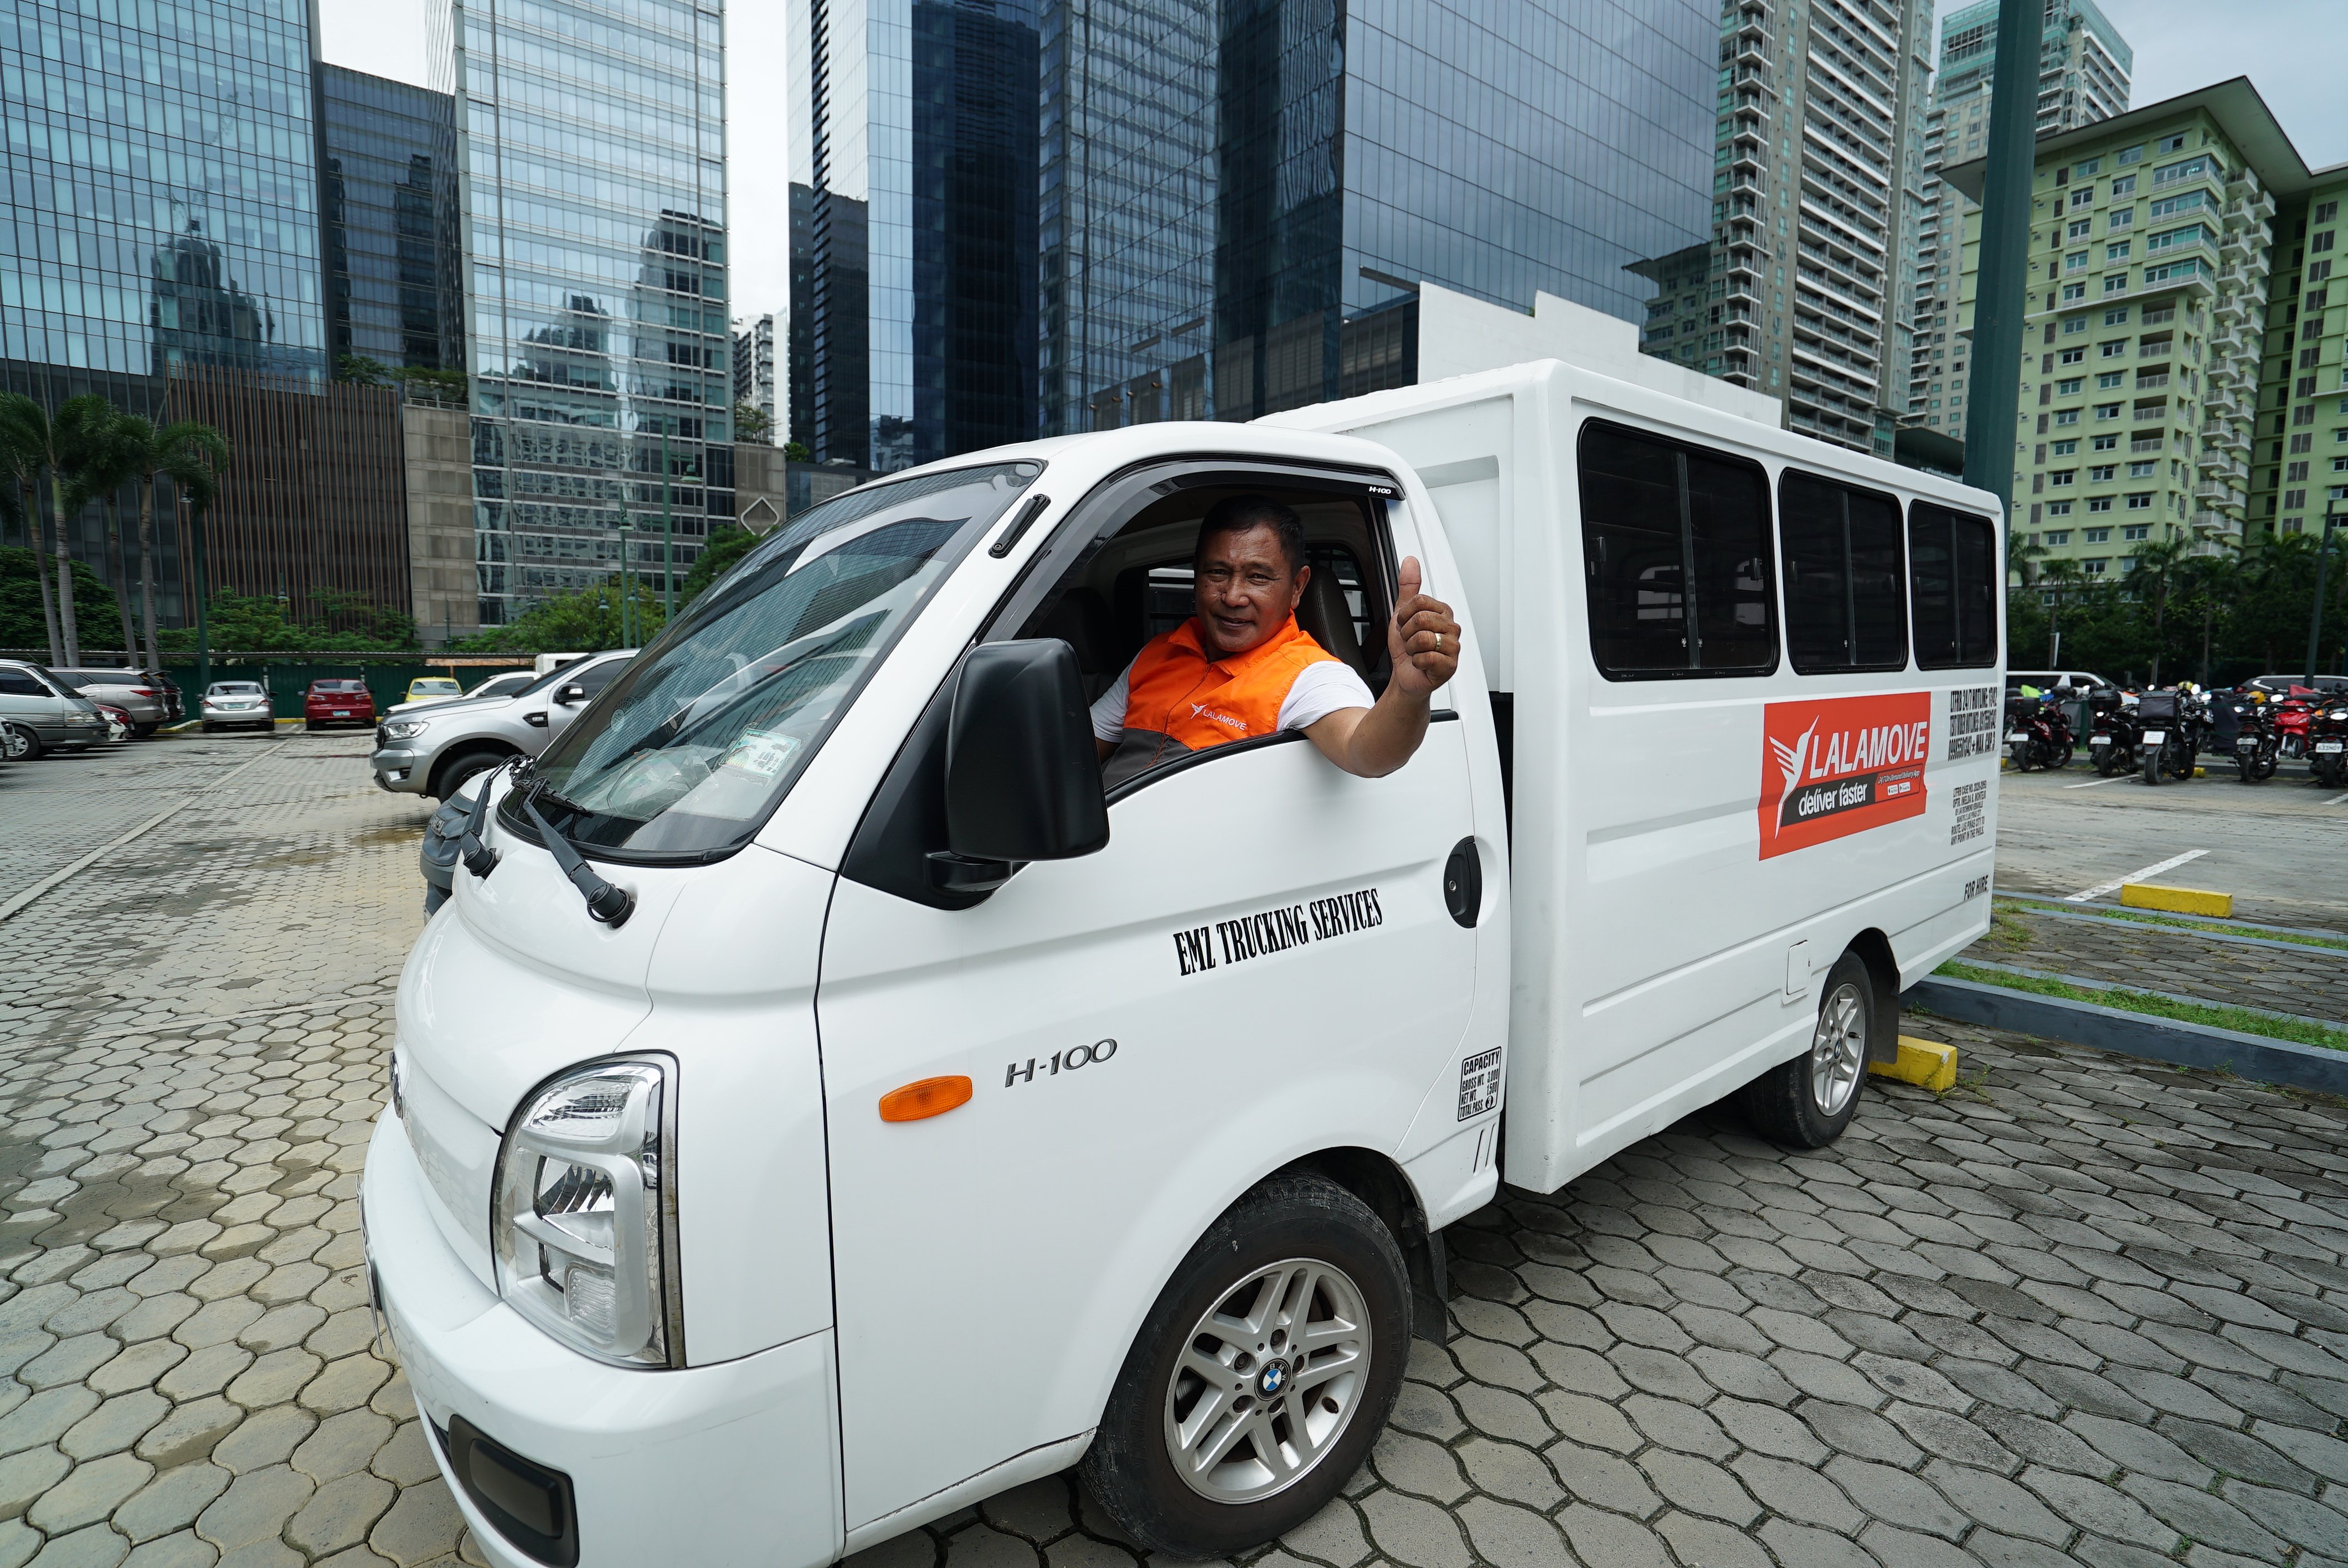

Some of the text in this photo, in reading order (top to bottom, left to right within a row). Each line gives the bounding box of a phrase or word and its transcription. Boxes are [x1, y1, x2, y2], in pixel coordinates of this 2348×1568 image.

[1369, 486, 1391, 494] H-100
[1950, 690, 1962, 713] LTFRB
[1203, 709, 1247, 730] LALAMOVE
[1809, 721, 1928, 779] LALAMOVE
[1799, 782, 1868, 817] deliver faster
[1981, 816, 1985, 825] TO
[1958, 832, 1966, 843] POINT
[1966, 831, 1969, 840] IN
[1964, 874, 1989, 901] FOR HIRE
[1173, 888, 1383, 976] EMZ TRUCKING SERVICES
[1005, 1038, 1118, 1088] H-100
[1464, 1050, 1500, 1076] CAPACITY
[1462, 1076, 1477, 1092] GROSS
[1461, 1092, 1469, 1106] NET
[1460, 1103, 1471, 1118] TOTAL
[1269, 1363, 1287, 1381] BMW
